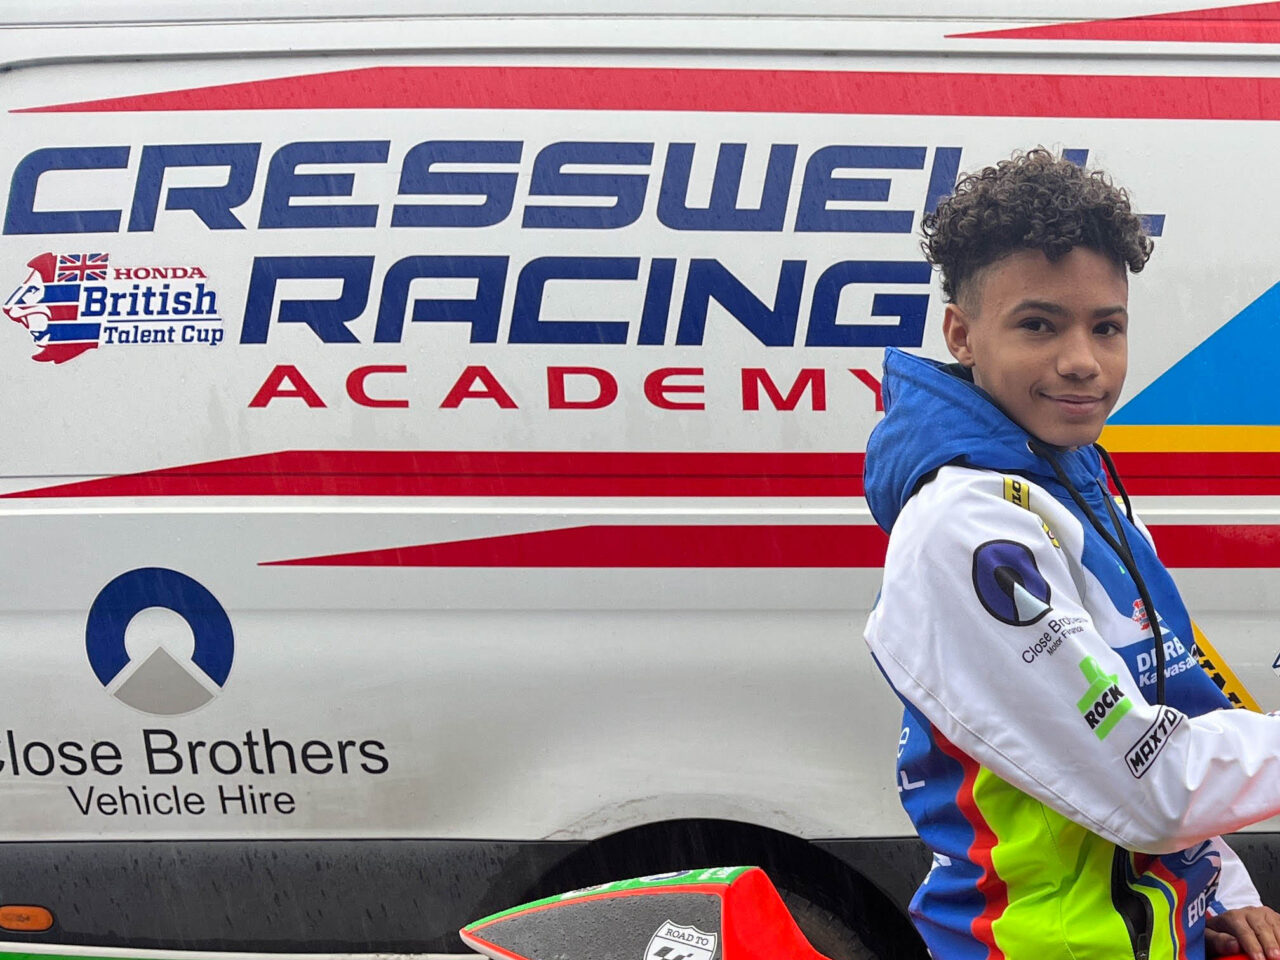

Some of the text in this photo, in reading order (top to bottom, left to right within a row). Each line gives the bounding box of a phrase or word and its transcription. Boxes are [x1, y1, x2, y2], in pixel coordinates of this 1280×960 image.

[113, 267, 207, 280] HONDA
[81, 283, 217, 316] British
[240, 255, 931, 347] RACING
[104, 325, 224, 346] Talent Cup
[1022, 632, 1052, 664] Close
[1084, 684, 1125, 730] ROCK
[0, 728, 390, 776] lose Brothers
[67, 784, 296, 815] Vehicle Hire
[665, 928, 709, 946] ROAD TO
